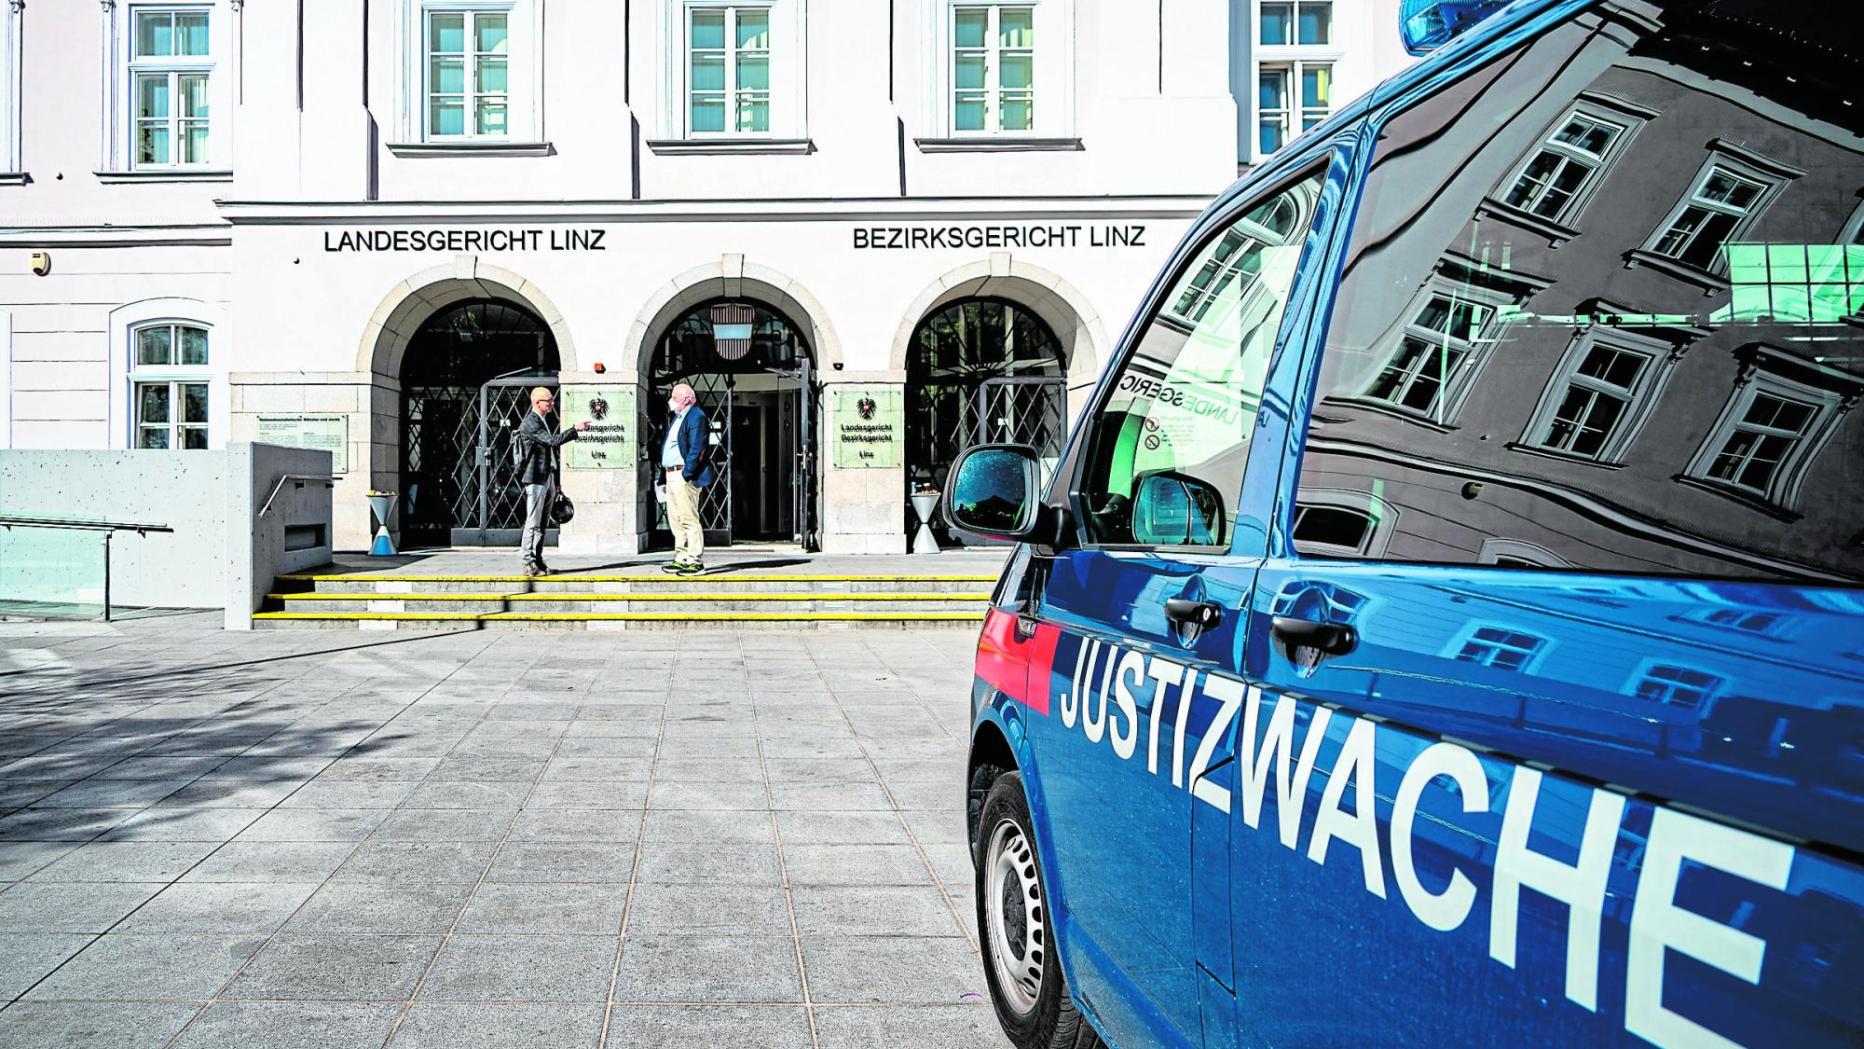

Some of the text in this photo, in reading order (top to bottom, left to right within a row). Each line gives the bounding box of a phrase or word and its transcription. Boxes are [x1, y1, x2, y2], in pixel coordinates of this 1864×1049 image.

[324, 229, 606, 252] LANDESGERICHT LINZ
[853, 225, 1146, 249] BEZIRKSGERICHT LINZ
[840, 423, 893, 434] Landesgericht
[840, 433, 893, 444] Bezirksgericht
[859, 450, 875, 460] Linz
[1060, 635, 1796, 1049] JUSTIZWACHE
